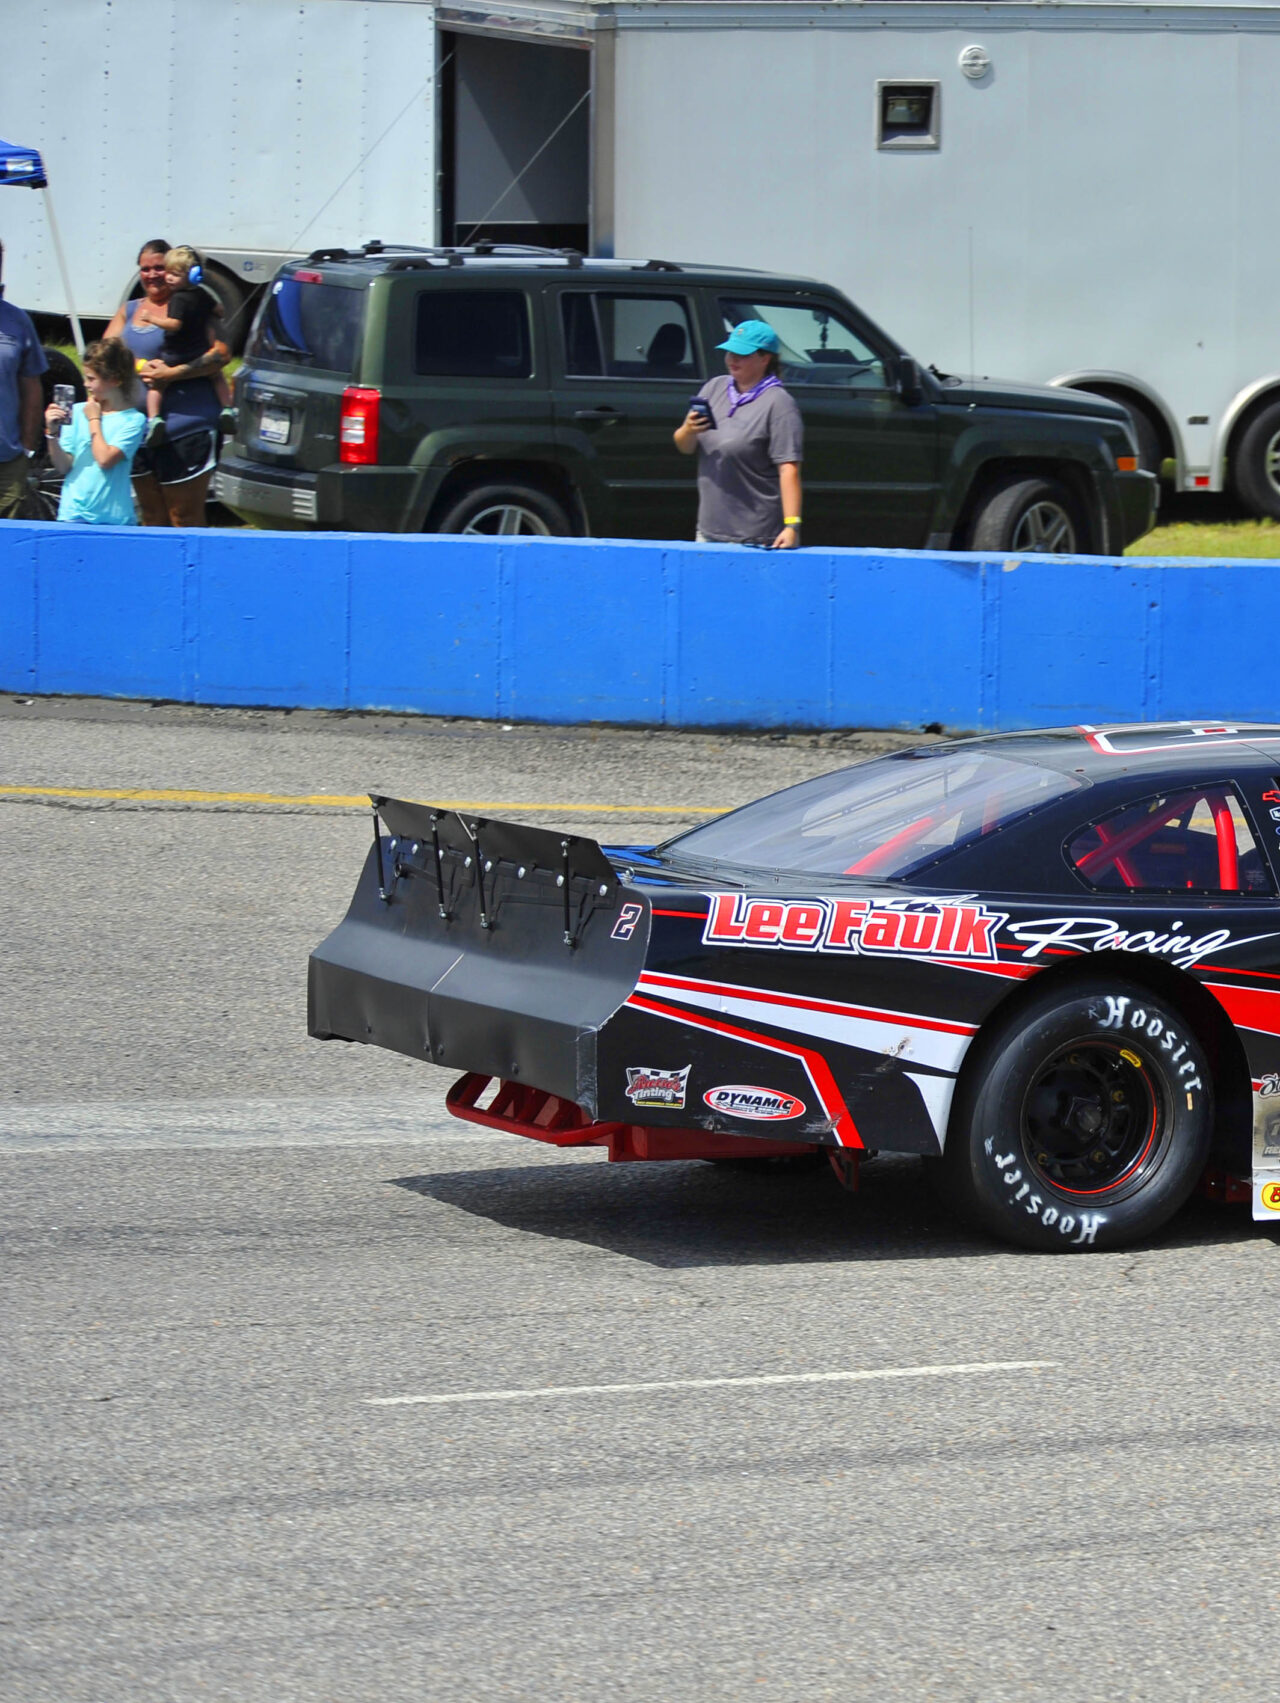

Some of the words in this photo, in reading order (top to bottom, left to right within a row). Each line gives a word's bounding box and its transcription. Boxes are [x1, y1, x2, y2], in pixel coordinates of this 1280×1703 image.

[611, 903, 643, 940] 2
[704, 892, 826, 952] Lee
[819, 897, 1000, 961] Faulk
[1098, 995, 1202, 1091] Hoosier
[716, 1091, 796, 1111] DYNAMIC
[994, 1152, 1108, 1244] Hoosier
